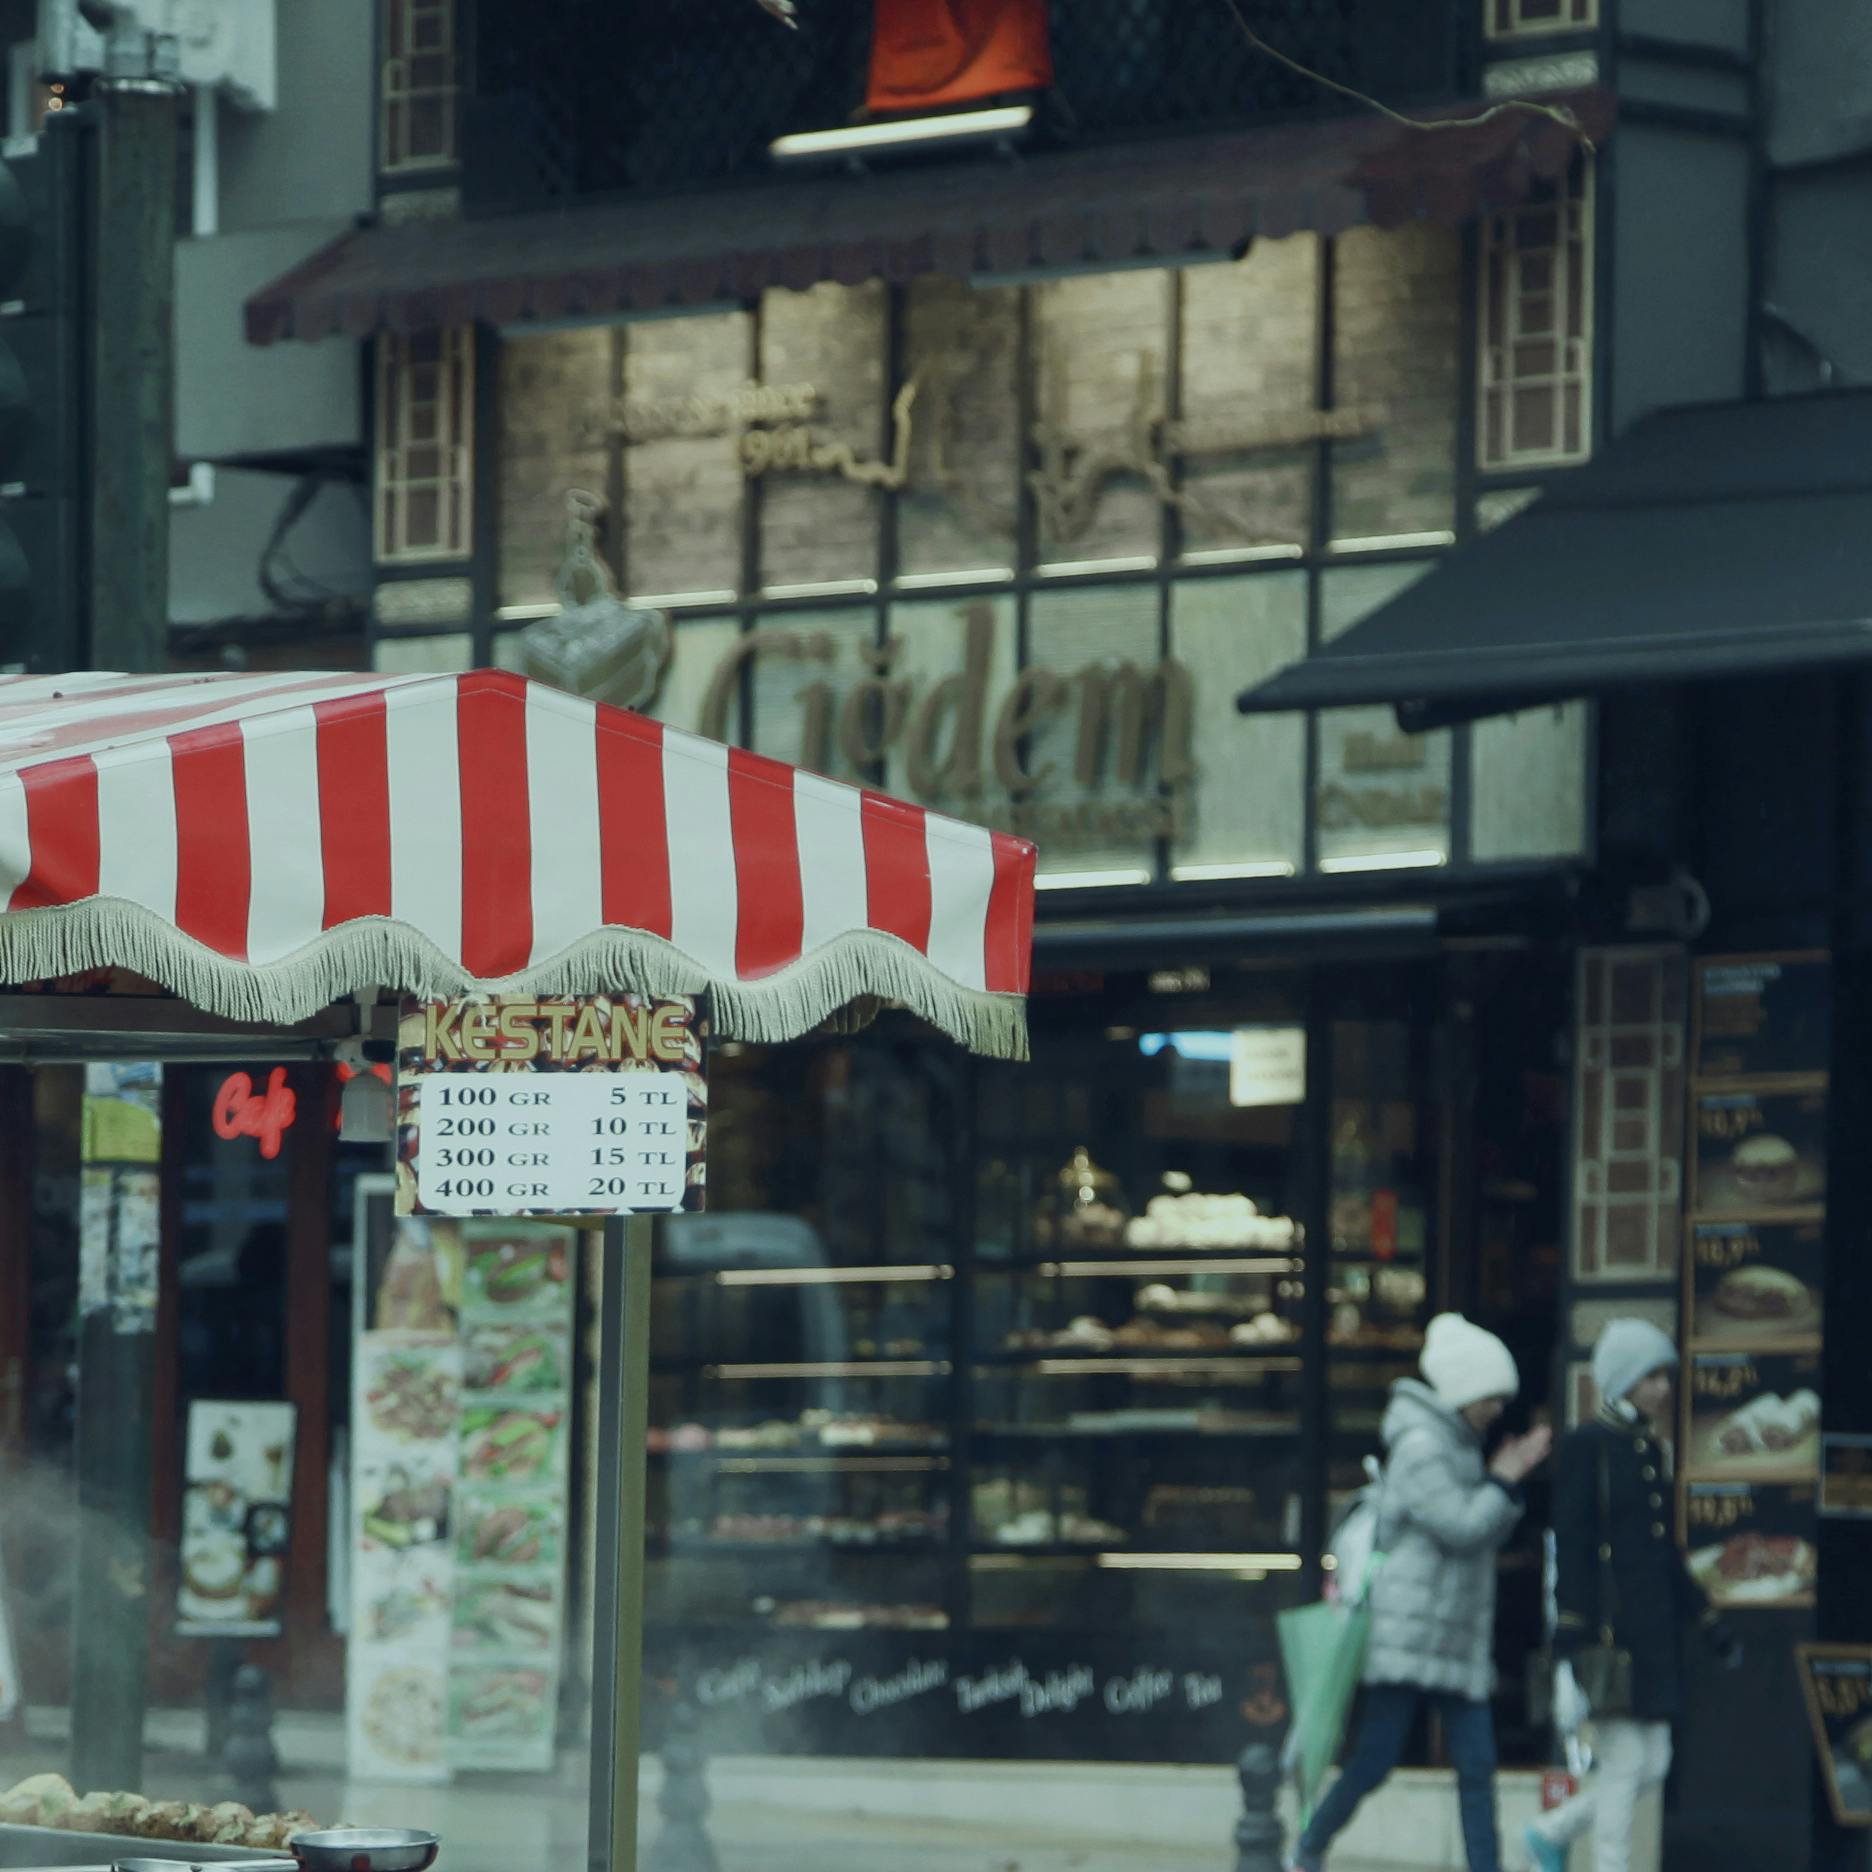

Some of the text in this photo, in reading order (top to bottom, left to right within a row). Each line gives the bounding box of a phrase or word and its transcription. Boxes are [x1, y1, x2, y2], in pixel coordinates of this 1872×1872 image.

[424, 1003, 687, 1062] KESTANE
[438, 1086, 677, 1107] 100 GR 5 TL
[436, 1117, 676, 1137] 200 GR 10 TL
[435, 1147, 676, 1167] 300 GR 15 TL
[435, 1177, 675, 1198] 400 GR 20 TL
